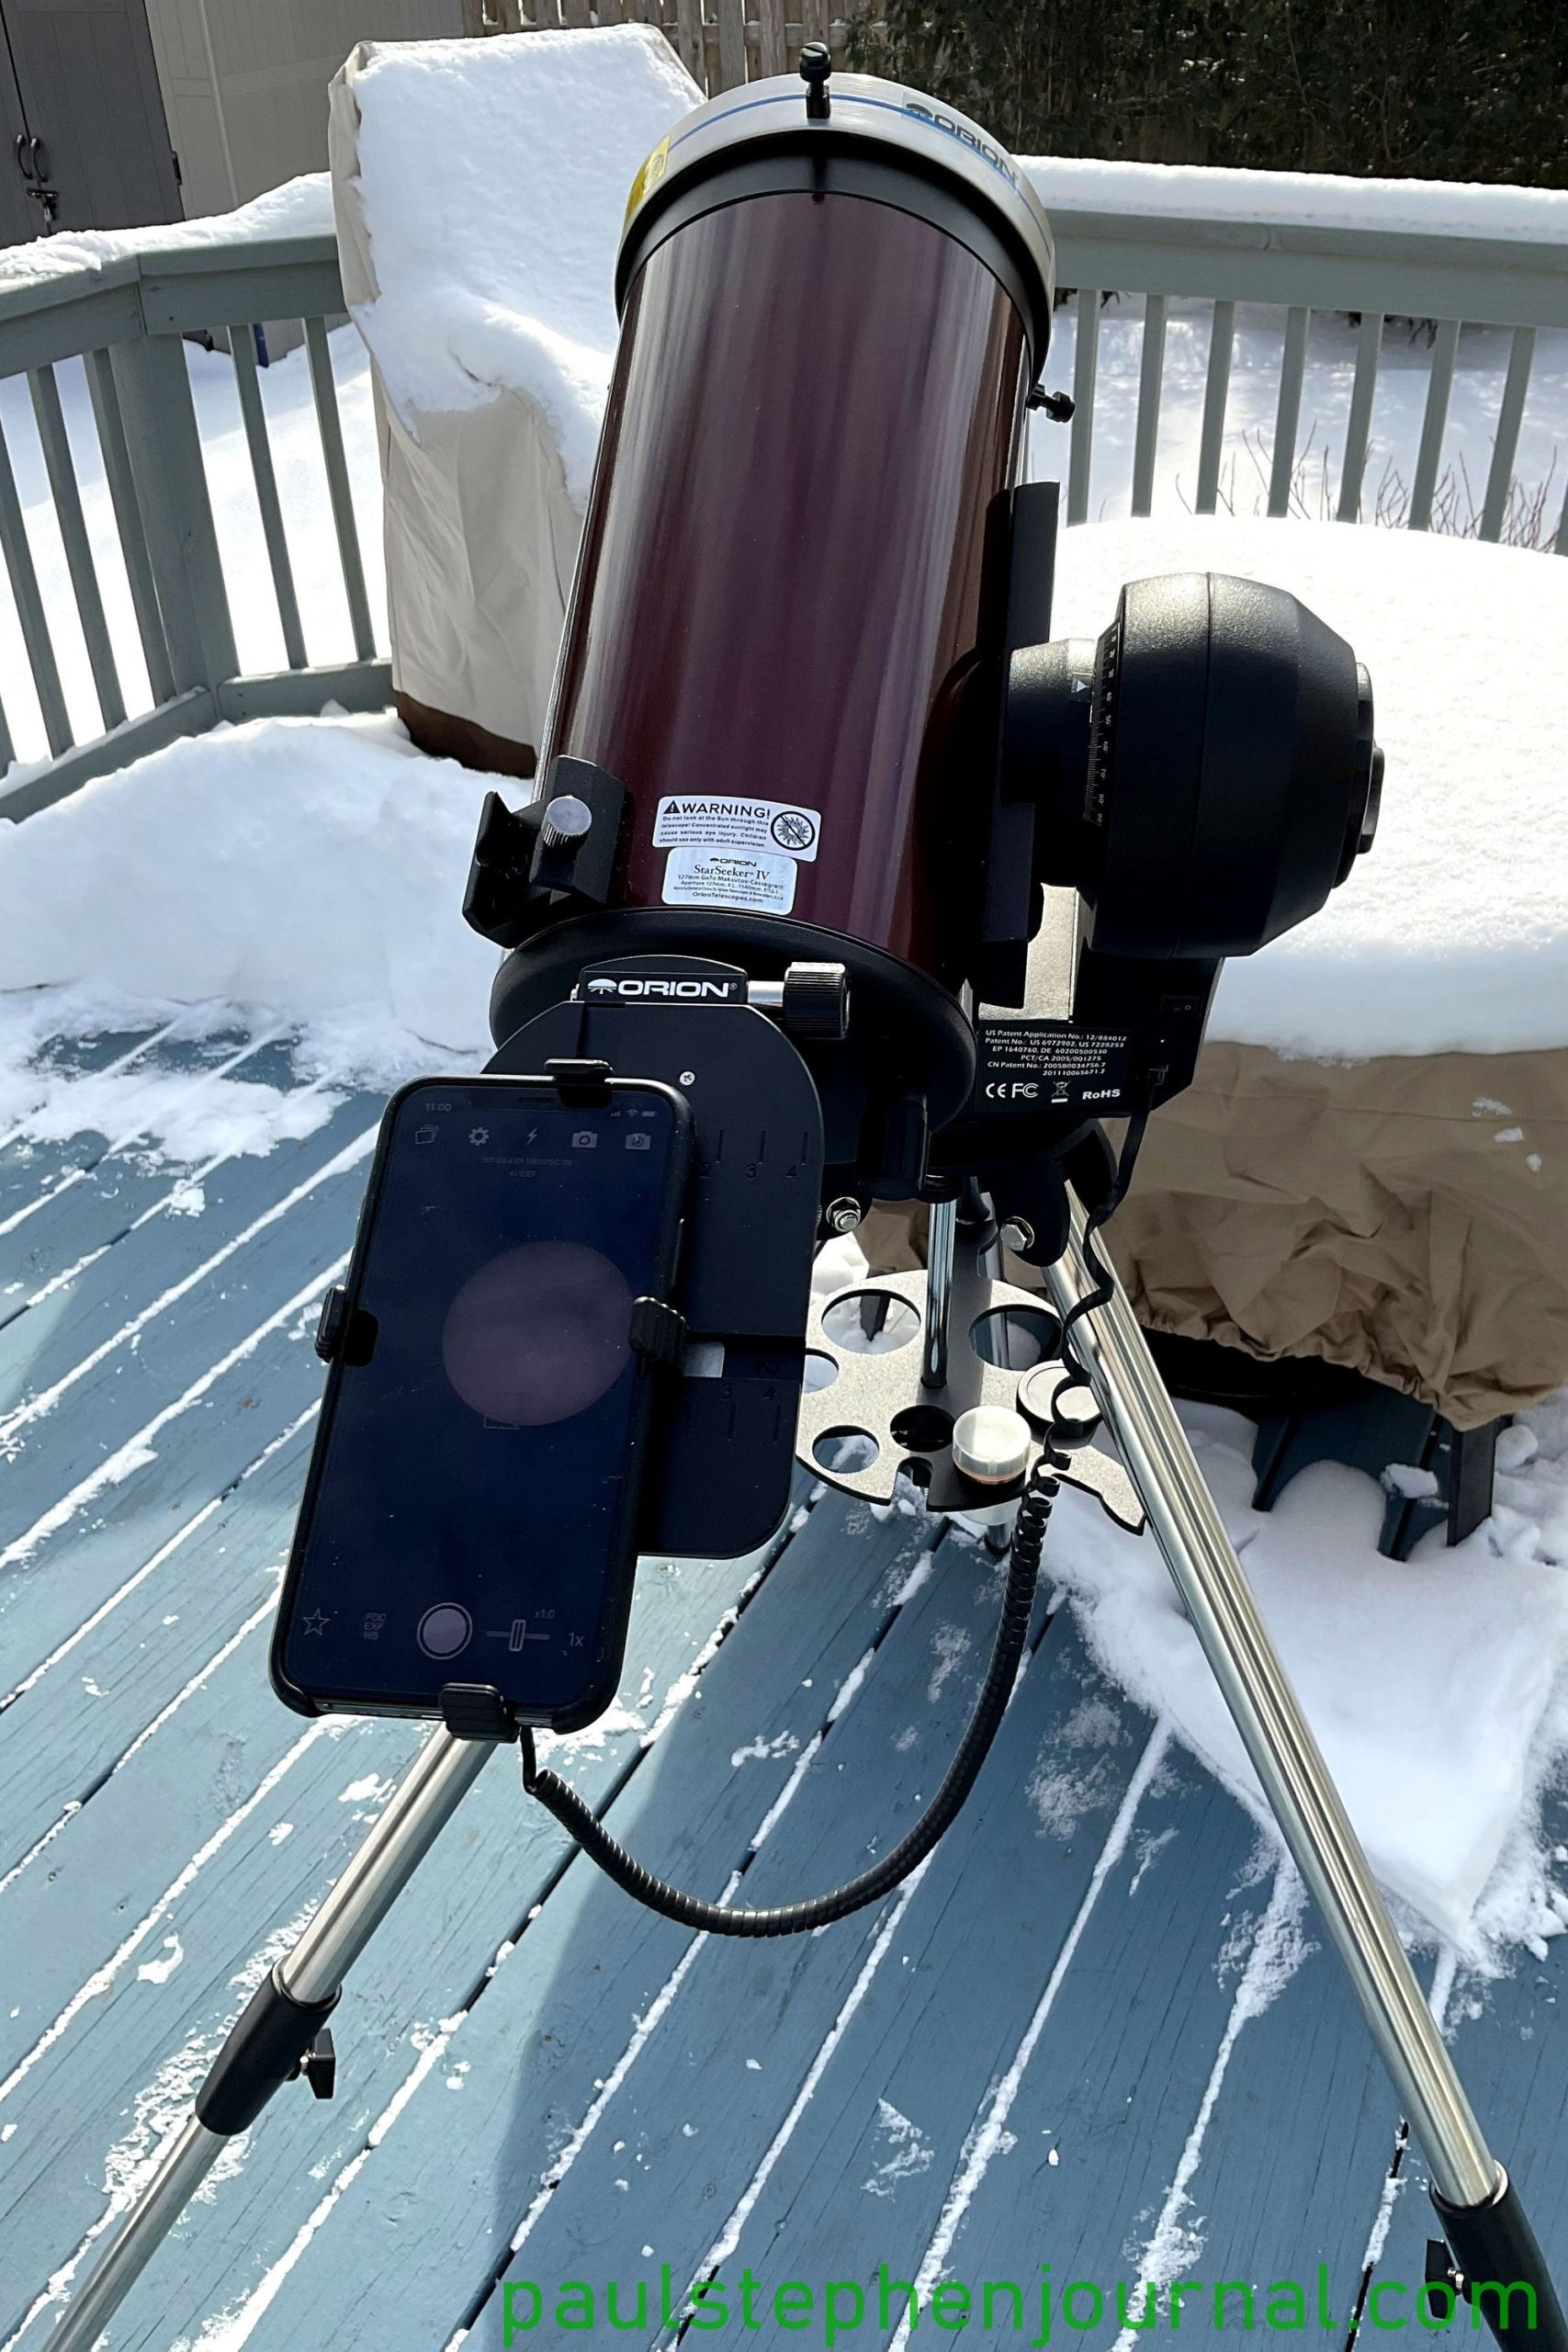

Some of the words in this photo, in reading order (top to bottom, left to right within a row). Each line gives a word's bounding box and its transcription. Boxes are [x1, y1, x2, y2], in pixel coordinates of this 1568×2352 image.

[935, 114, 1016, 189] ORION
[682, 803, 770, 819] WARNING!
[720, 858, 757, 867] ORION
[757, 870, 770, 880] IV
[718, 877, 784, 889] Maksutov-Cassegrain
[692, 891, 764, 903] OrionTelescopes.com
[1082, 1089, 1121, 1100] RoHS
[569, 1632, 585, 1646] 1x
